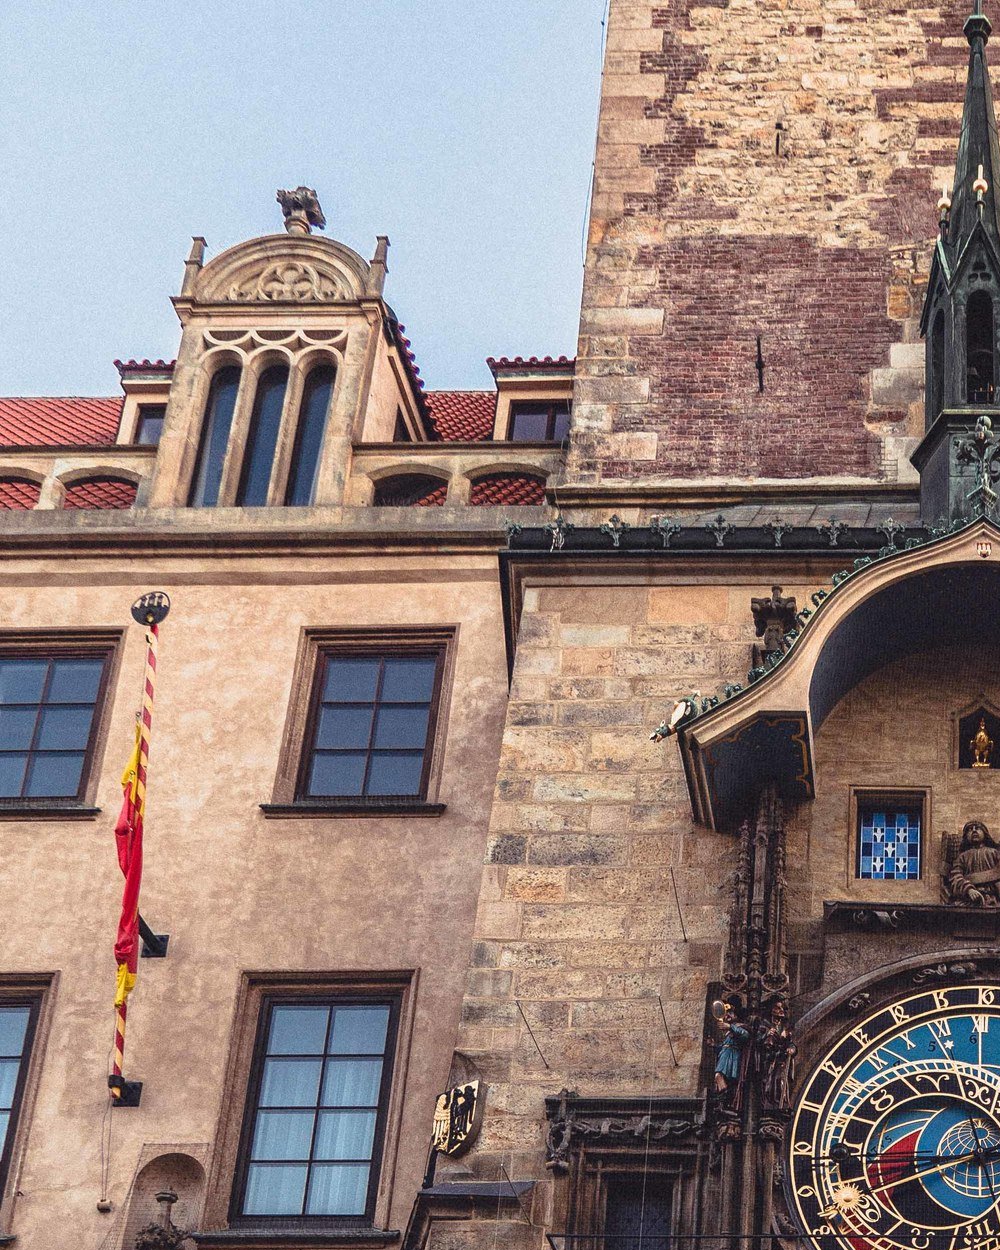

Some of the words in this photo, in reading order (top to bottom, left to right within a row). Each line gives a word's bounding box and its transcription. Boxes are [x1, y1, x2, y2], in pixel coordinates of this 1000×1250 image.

[971, 1015, 989, 1033] XII
[900, 1031, 917, 1050] X
[927, 1040, 937, 1052] 5
[969, 1034, 977, 1044] 6
